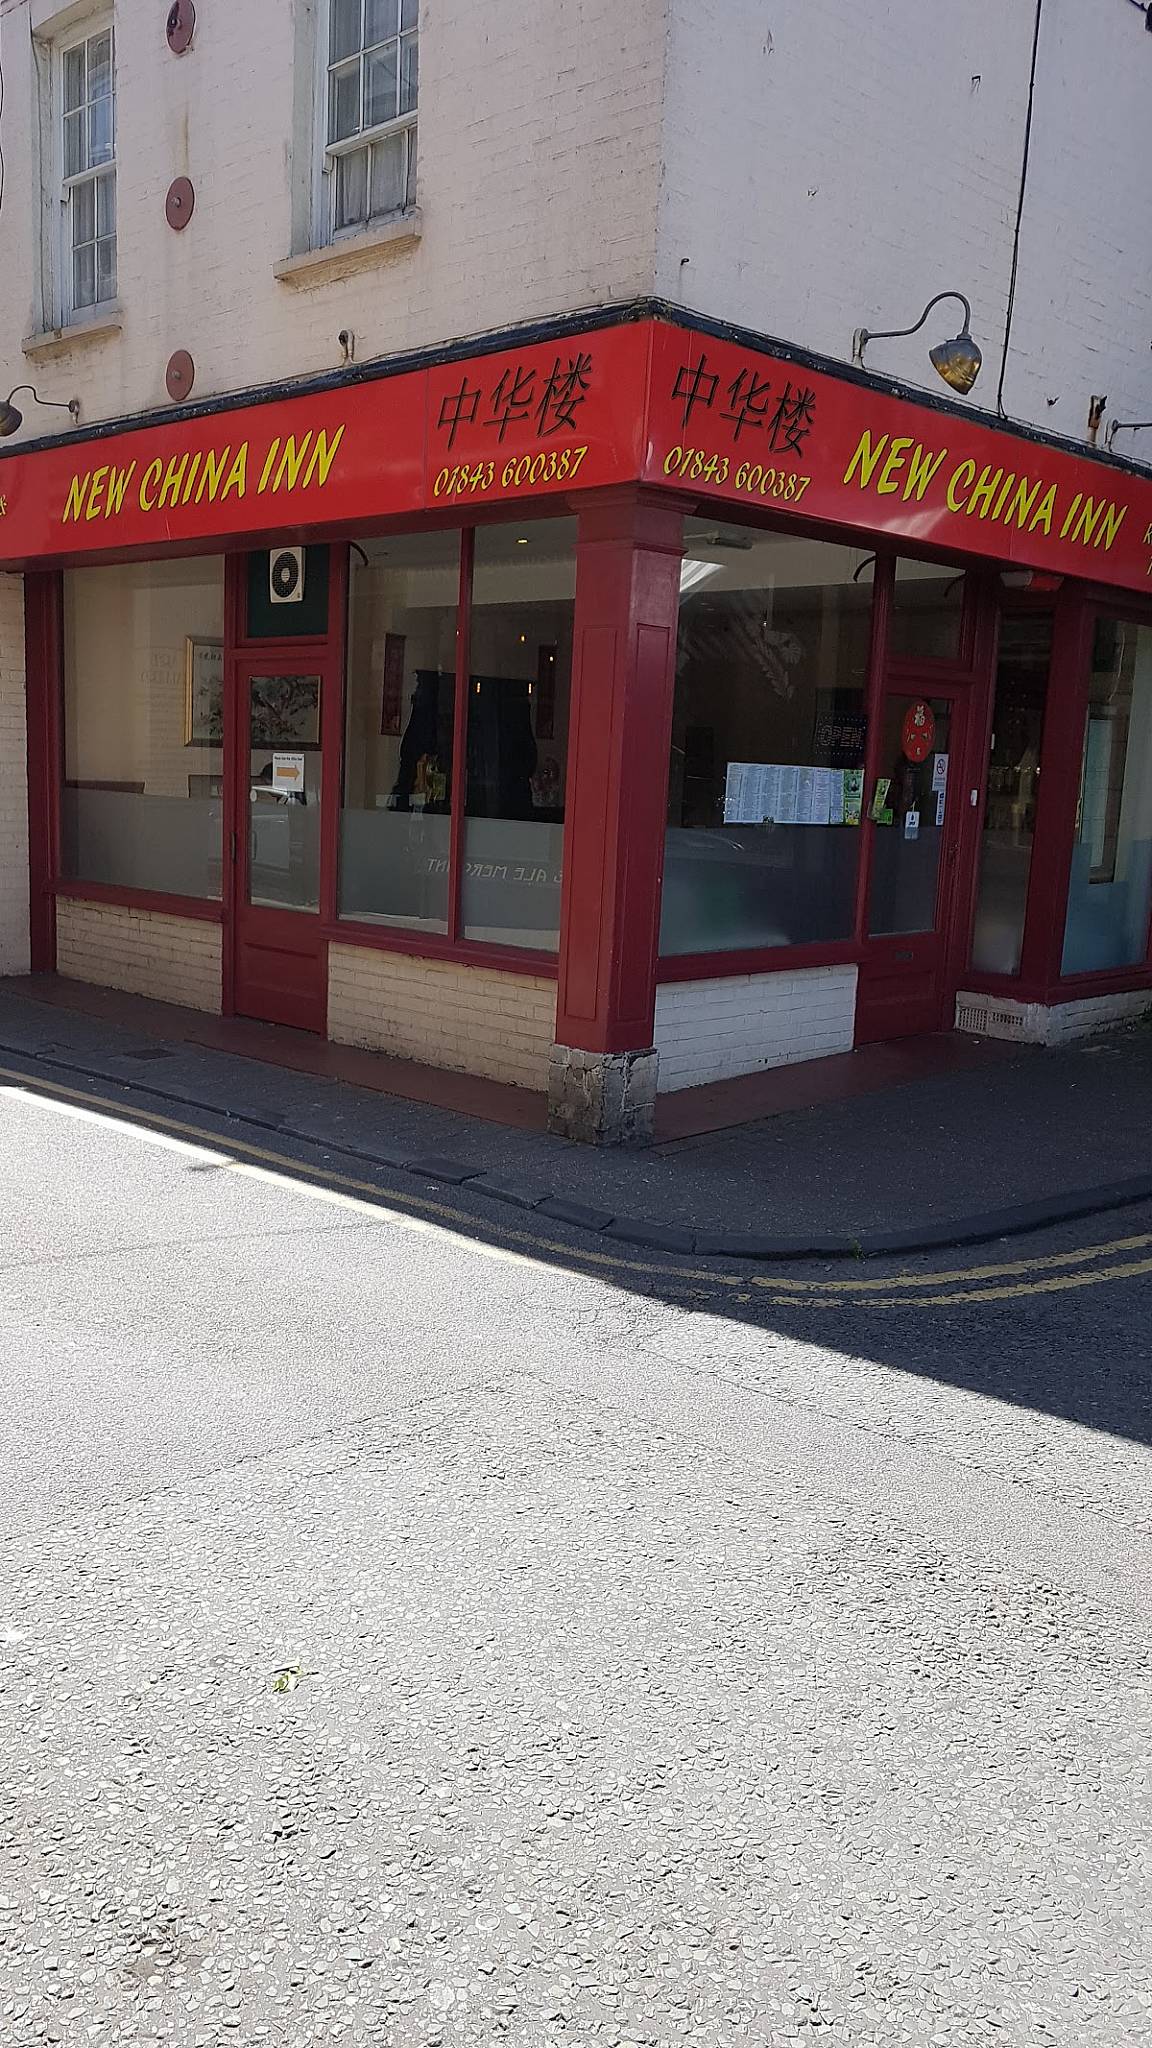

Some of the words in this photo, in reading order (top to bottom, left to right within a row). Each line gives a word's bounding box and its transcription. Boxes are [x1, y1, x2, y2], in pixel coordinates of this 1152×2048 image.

[437, 352, 593, 452] 中华楼
[671, 353, 816, 458] 中华楼
[62, 460, 136, 523] NEW
[139, 440, 249, 512] CHINA
[256, 423, 346, 494] INN
[433, 461, 495, 497] 01843
[501, 446, 589, 488] 600387
[663, 446, 730, 485] 01843
[735, 461, 811, 502] 600387
[843, 429, 948, 502] NEW
[946, 458, 1058, 536] CHINA
[1059, 492, 1129, 551] INN
